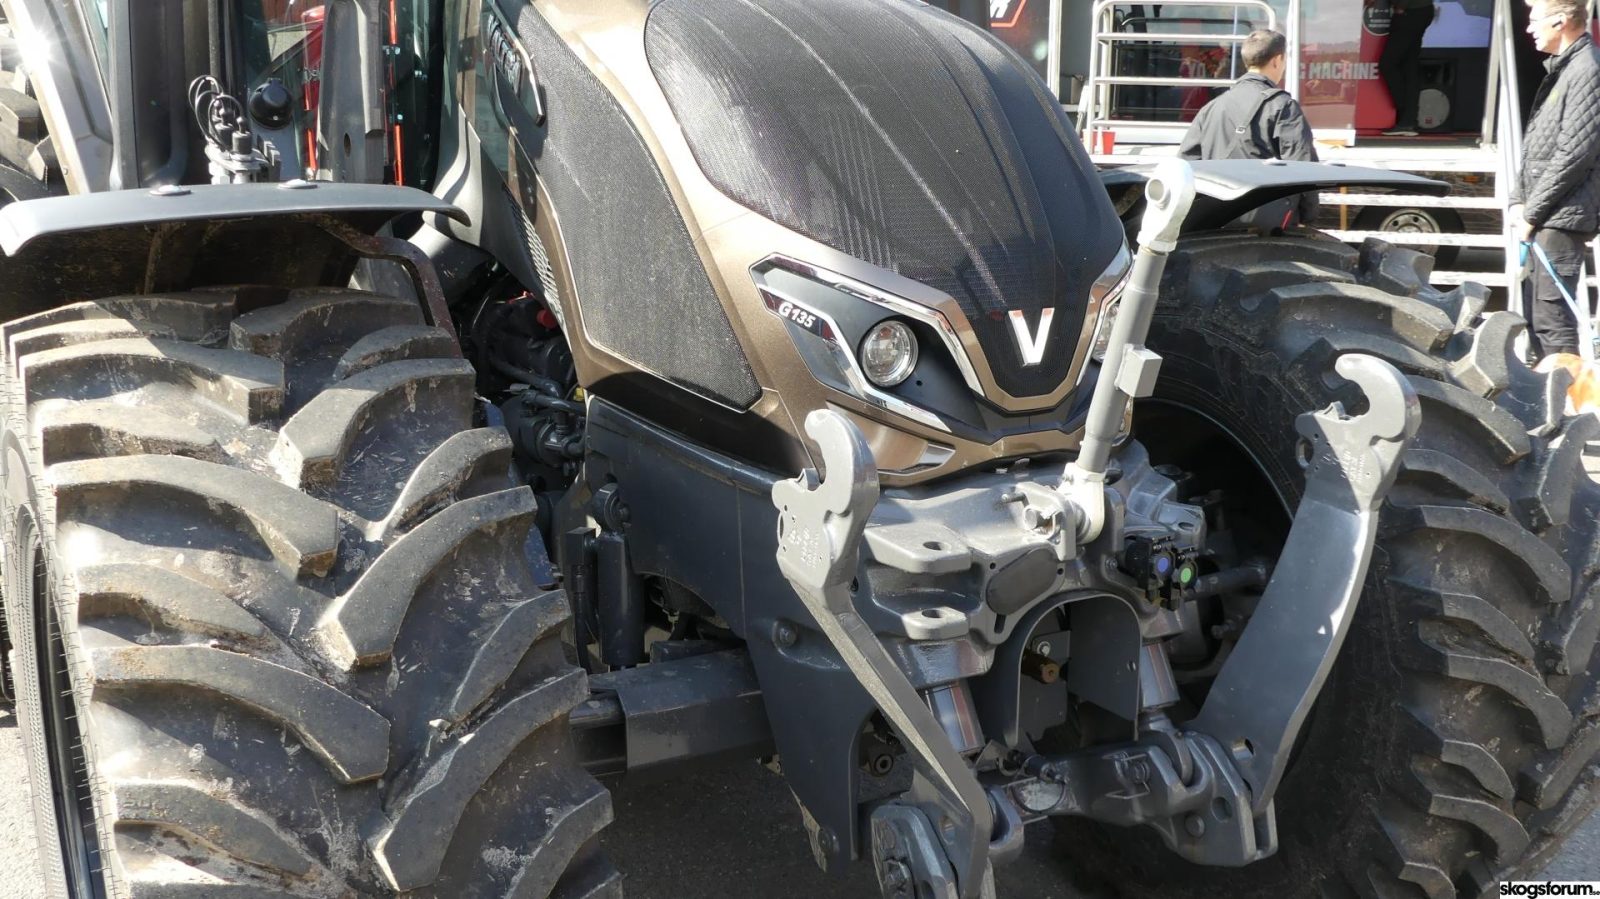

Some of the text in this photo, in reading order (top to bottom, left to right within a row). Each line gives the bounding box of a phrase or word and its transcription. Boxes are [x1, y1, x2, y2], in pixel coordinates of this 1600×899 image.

[1308, 62, 1379, 80] MACHINE
[778, 300, 817, 328] G135
[1007, 307, 1055, 367] V
